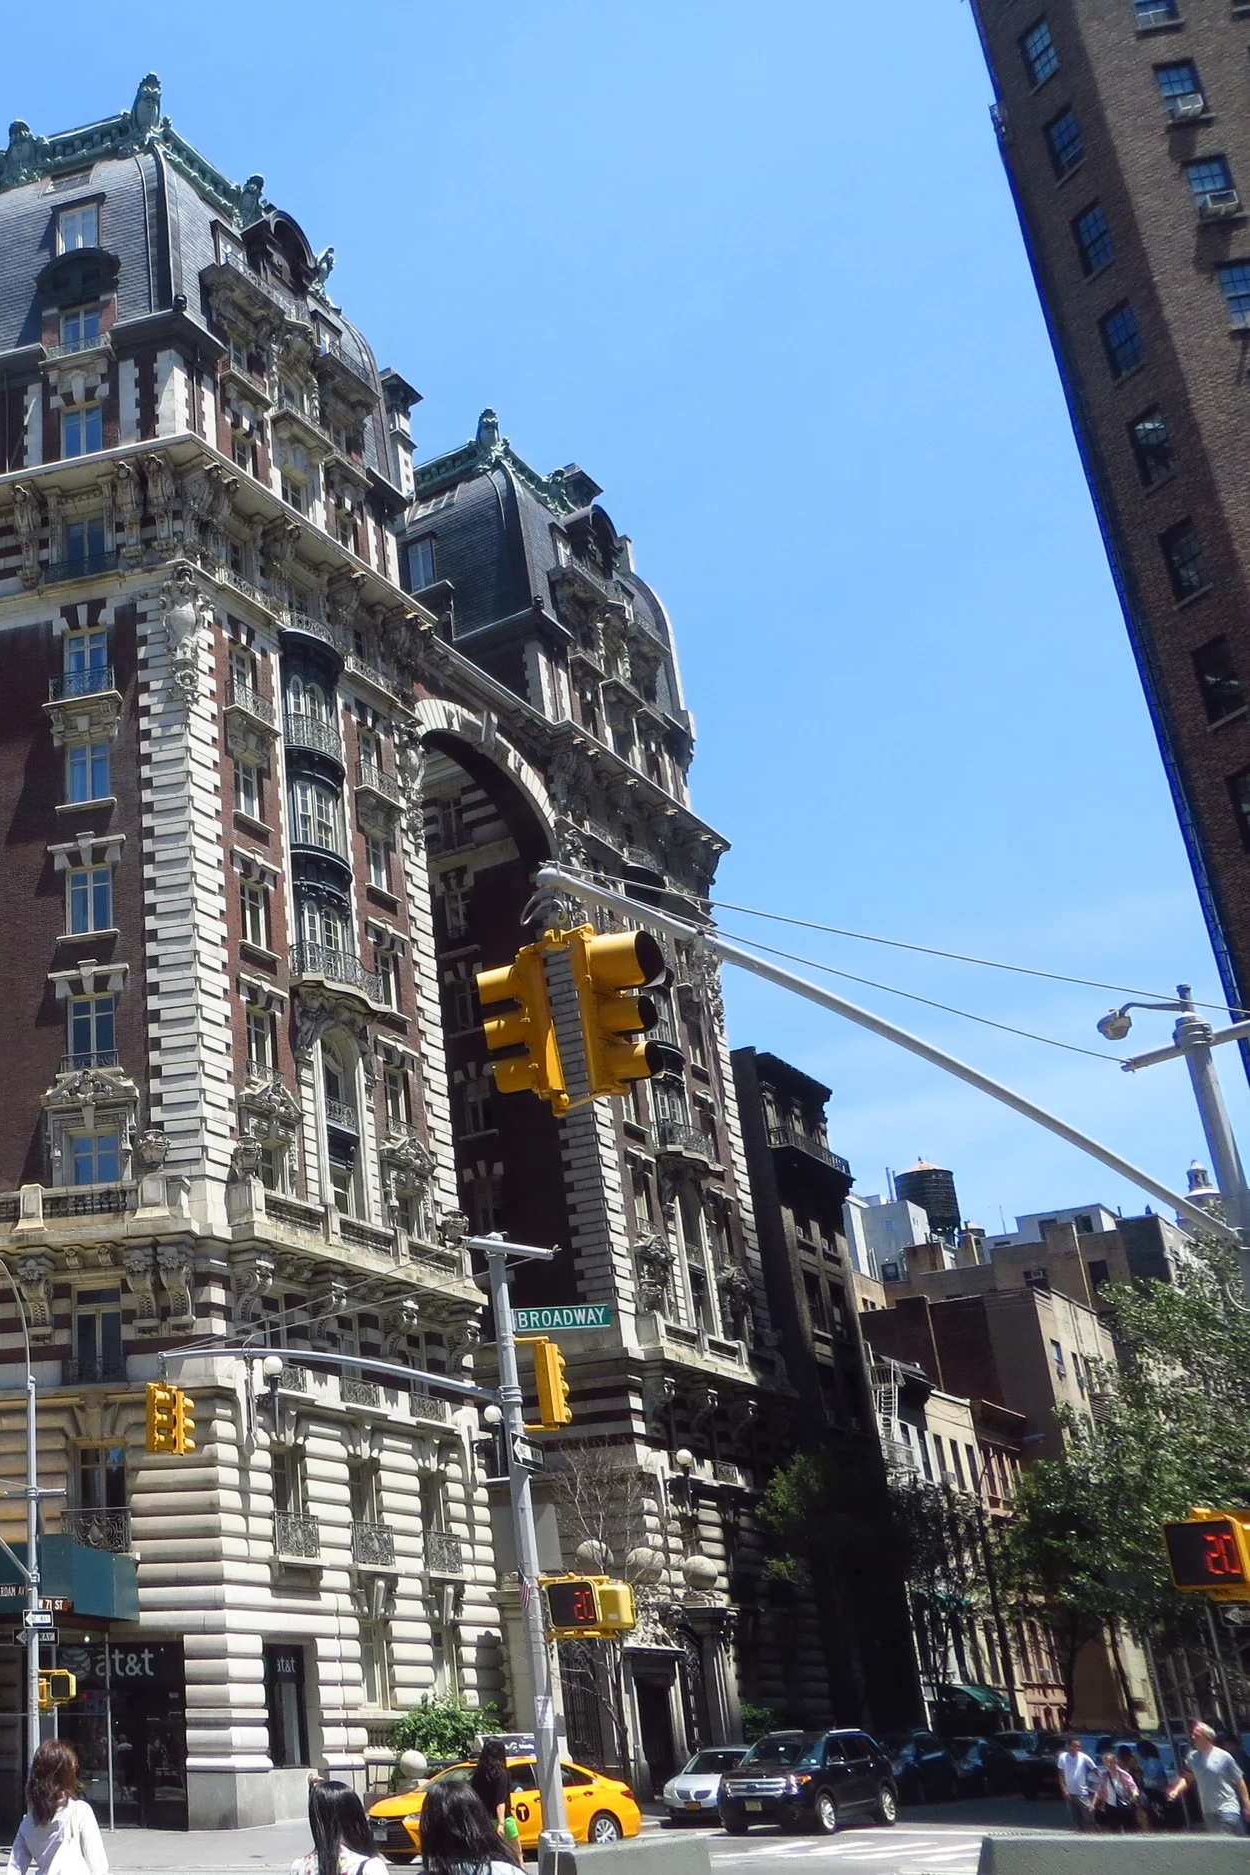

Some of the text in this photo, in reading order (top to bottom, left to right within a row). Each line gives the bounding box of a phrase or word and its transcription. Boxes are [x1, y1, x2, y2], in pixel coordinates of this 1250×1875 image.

[517, 1307, 606, 1328] BROADWAY
[1202, 1534, 1243, 1575] 20
[45, 1599, 52, 1610] 71
[54, 1600, 64, 1611] ST
[572, 1591, 596, 1620] 20
[95, 1648, 154, 1677] at&t
[517, 1806, 528, 1820] T
